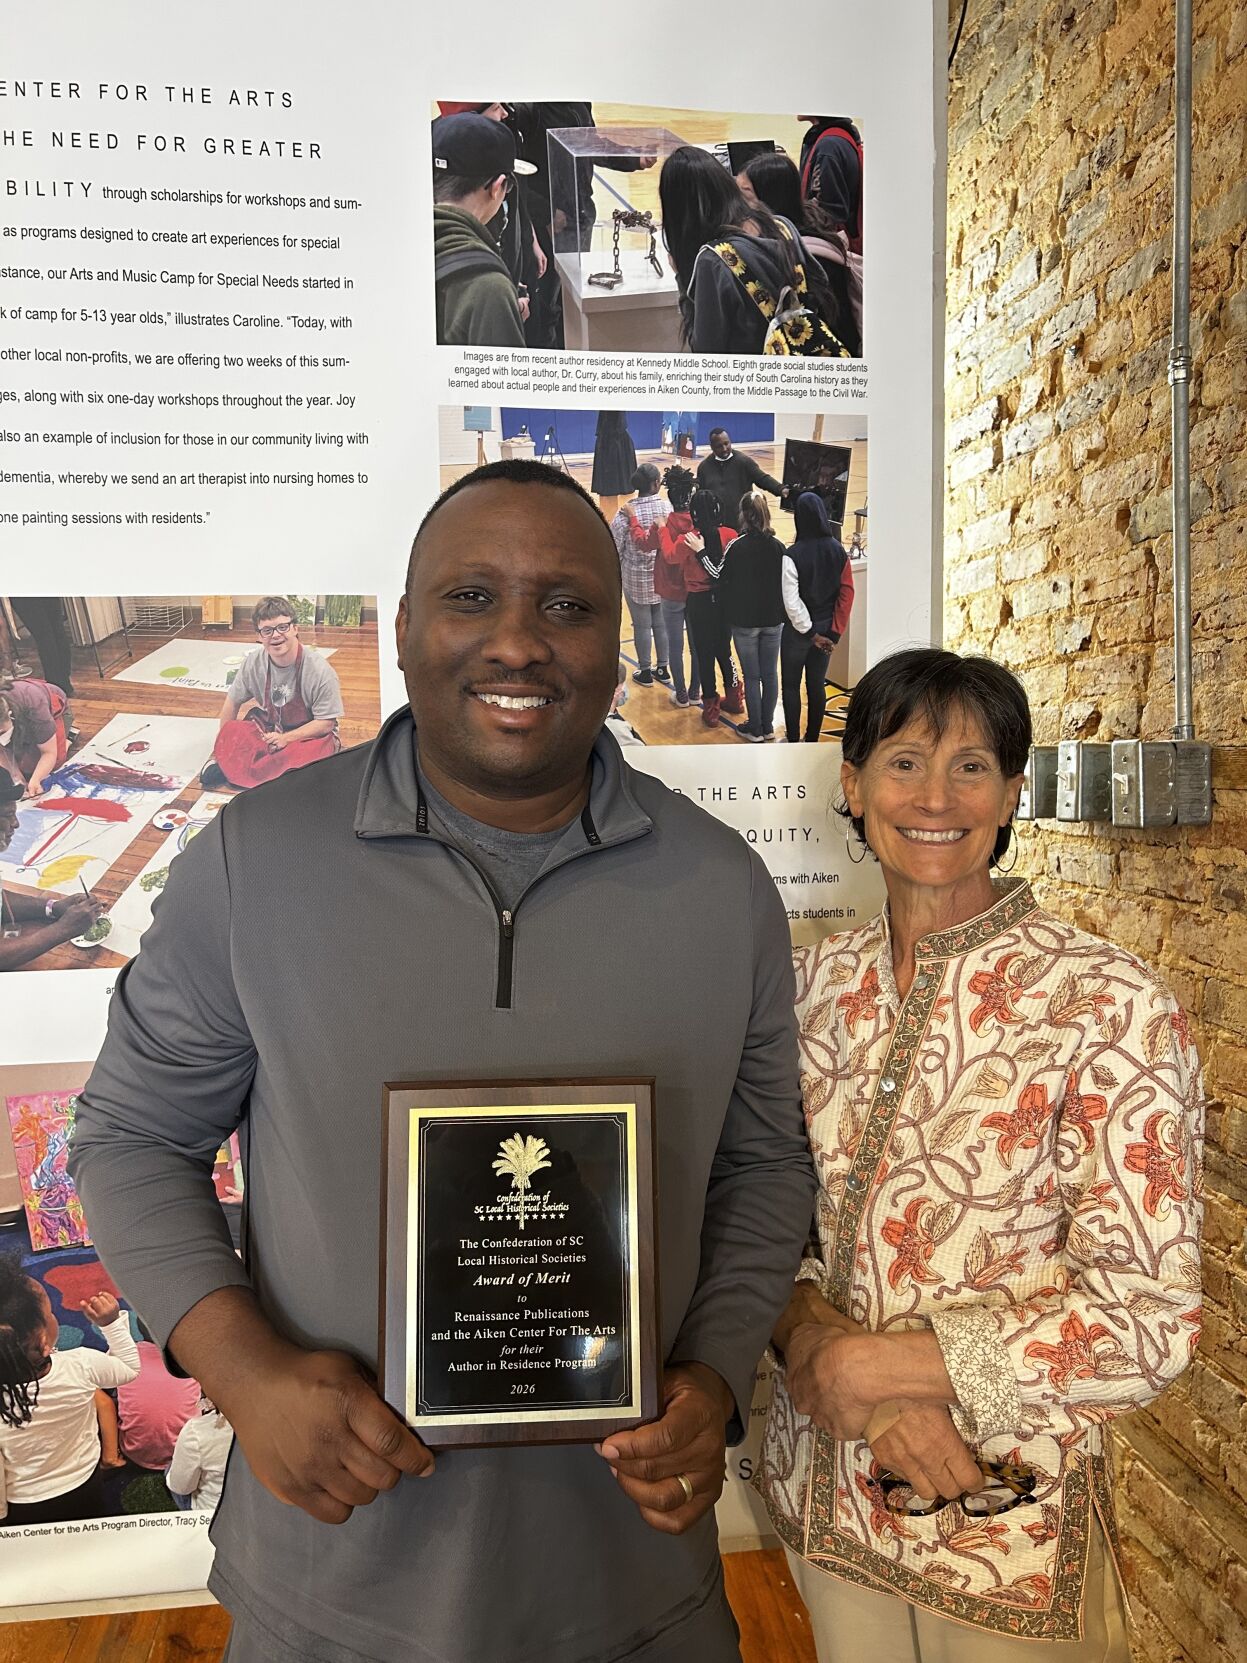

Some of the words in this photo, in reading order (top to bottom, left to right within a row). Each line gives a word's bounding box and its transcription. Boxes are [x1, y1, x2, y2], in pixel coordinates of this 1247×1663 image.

[99, 83, 147, 101] FOR
[164, 86, 211, 103] THE
[228, 89, 291, 108] ARTS
[3, 130, 33, 146] HE
[52, 131, 118, 149] NEED
[137, 134, 185, 152] FOR
[203, 137, 321, 159] GREATER
[6, 179, 91, 197] BILITY
[102, 185, 147, 202] through
[150, 188, 223, 206] scholarships
[225, 190, 242, 204] for
[244, 193, 306, 210] workshops
[309, 195, 330, 208] and
[333, 199, 362, 209] sum-
[2, 226, 17, 236] as
[20, 227, 76, 240] programs
[79, 226, 133, 243] designed
[136, 228, 148, 241] to
[151, 230, 187, 243] create
[191, 231, 207, 244] art
[209, 232, 279, 247] experiences
[282, 234, 298, 247] for
[300, 236, 340, 251] special
[0, 265, 43, 280] stance,
[47, 269, 67, 279] our
[69, 267, 93, 280] Arts
[96, 268, 118, 281] and
[122, 268, 157, 282] Music
[160, 270, 195, 287] Camp
[197, 271, 213, 285] for
[216, 272, 258, 288] Special
[262, 274, 299, 288] Needs
[302, 276, 340, 288] started
[343, 276, 353, 288] in
[10, 306, 22, 319] of
[25, 309, 57, 323] camp
[60, 307, 77, 320] for
[80, 308, 106, 322] 5-13
[110, 312, 136, 325] year
[174, 312, 229, 326] illustrates
[232, 313, 283, 327] Caroline.
[329, 315, 352, 328] with
[0, 347, 31, 360] other
[34, 348, 61, 361] local
[65, 350, 131, 365] non-profits,
[134, 354, 151, 364] we
[155, 354, 174, 365] are
[177, 352, 220, 369] offering
[223, 354, 243, 366] two
[246, 354, 282, 367] weeks
[285, 354, 296, 367] of
[299, 354, 319, 367] this
[322, 357, 349, 367] sum-
[463, 350, 493, 363] Images
[495, 354, 509, 362] are
[511, 352, 529, 362] from
[531, 355, 557, 364] recent
[558, 355, 584, 365] author
[586, 356, 624, 367] residency
[626, 358, 634, 366] at
[636, 357, 671, 368] Kennedy
[673, 358, 699, 368] Middle
[701, 358, 730, 368] School.
[732, 359, 757, 370] Eighth
[758, 360, 781, 371] grade
[783, 361, 805, 370] social
[807, 361, 834, 371] studies
[835, 362, 868, 372] students
[454, 365, 490, 376] engaged
[491, 366, 508, 375] with
[510, 366, 529, 376] local
[531, 368, 559, 379] author,
[561, 368, 573, 378] Dr.
[575, 369, 599, 381] Curry,
[600, 370, 623, 380] about
[625, 370, 637, 380] his
[666, 371, 702, 383] enriching
[703, 372, 721, 381] their
[723, 372, 744, 384] study
[745, 372, 754, 382] of
[755, 372, 778, 382] South
[780, 373, 812, 383] Carolina
[813, 374, 839, 386] history
[840, 377, 850, 385] as
[851, 375, 868, 388] they
[24, 432, 39, 442] an
[42, 431, 92, 446] example
[96, 431, 107, 443] of
[110, 431, 160, 444] inclusion
[164, 432, 179, 445] for
[182, 432, 214, 445] those
[217, 432, 227, 445] in
[230, 435, 249, 445] our
[251, 432, 312, 447] community
[315, 432, 343, 447] living
[346, 432, 368, 444] with
[697, 786, 737, 802] THE
[751, 784, 806, 800] ARTS
[742, 827, 820, 845] QUITY,
[789, 872, 809, 884] with
[811, 871, 839, 883] Aiken
[802, 907, 844, 920] students
[846, 906, 855, 917] in
[496, 1191, 541, 1206] Confederation
[542, 1190, 551, 1204] of
[459, 1238, 478, 1248] The
[481, 1236, 552, 1248] Confederation
[555, 1235, 567, 1246] of
[569, 1235, 583, 1245] SC
[457, 1255, 485, 1266] Local
[488, 1254, 537, 1264] Historical
[541, 1252, 586, 1263] Societies
[472, 1273, 515, 1286] Award
[518, 1272, 534, 1287] of
[534, 1271, 570, 1283] Merit
[454, 1310, 520, 1322] Renaissance
[523, 1307, 589, 1319] Publications
[431, 1329, 450, 1340] and
[454, 1329, 470, 1339] the
[473, 1328, 505, 1339] Aiken
[509, 1326, 545, 1338] Center
[548, 1326, 567, 1336] For
[569, 1325, 590, 1336] The
[593, 1324, 616, 1336] Arts
[499, 1344, 516, 1357] for
[519, 1344, 544, 1354] their
[447, 1360, 483, 1371] Author
[486, 1360, 496, 1370] in
[499, 1358, 551, 1369] Residence
[554, 1356, 596, 1370] Program
[510, 1383, 535, 1394] 2026
[23, 1528, 52, 1537] Center
[53, 1526, 65, 1534] for
[66, 1525, 80, 1533] the
[81, 1523, 99, 1532] Arts
[100, 1520, 137, 1531] Program
[139, 1517, 172, 1527] Director,
[175, 1515, 197, 1527] Tracy
